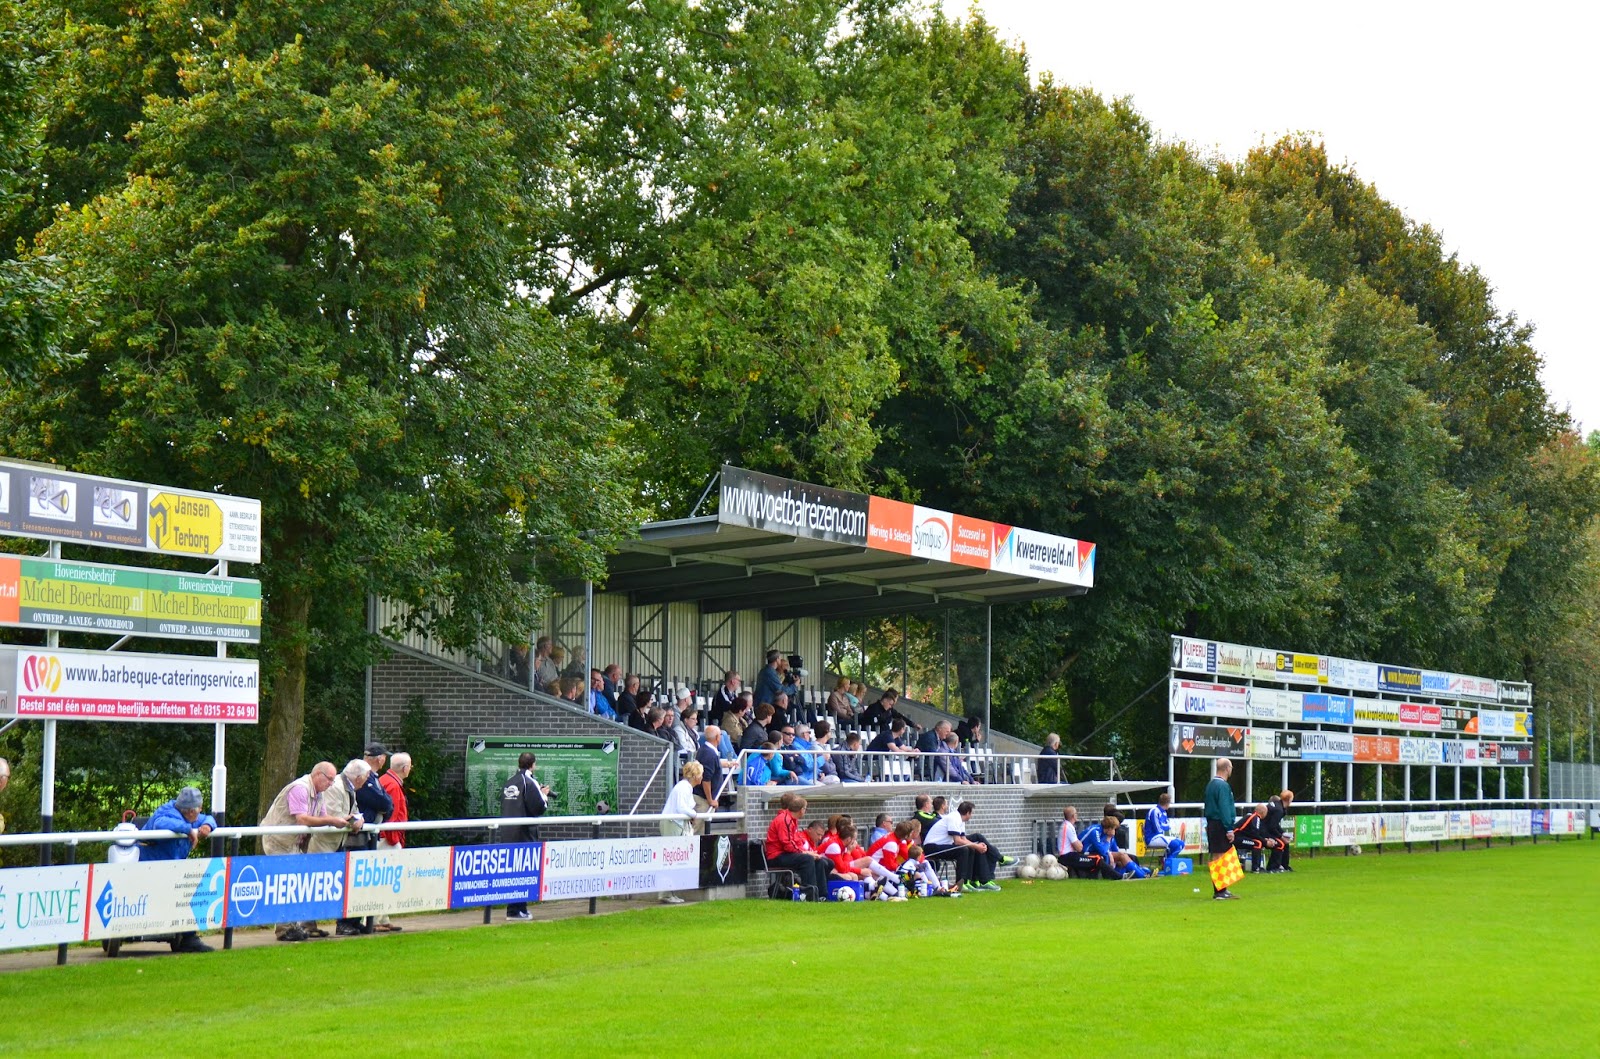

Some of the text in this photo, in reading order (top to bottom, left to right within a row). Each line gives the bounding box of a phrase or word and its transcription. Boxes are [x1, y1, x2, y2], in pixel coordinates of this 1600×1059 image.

[174, 495, 210, 518] Jansen
[723, 486, 867, 537] www.voetbalreizen.com
[173, 525, 210, 554] Terborg
[869, 523, 912, 543] Werving & Selectie
[914, 525, 942, 556] Symbus
[958, 525, 986, 542] Succesvol in
[953, 541, 989, 559] Loopbaanadvies
[1016, 534, 1076, 568] kwerreveld.nl
[54, 563, 117, 585] Hoveniersbedrijf
[23, 579, 145, 614] Michel Boerkamp.nl
[178, 577, 234, 597] Hoveniersbedrijf
[151, 592, 258, 624] Michel Boerkamp.nl
[33, 612, 134, 630] ONTWERP AANLEG ONDERHOUD
[159, 623, 250, 638] ONTWERP AANLEG ONDERHOUD
[65, 664, 257, 691] www.barbeque-cateringservice.nl
[20, 698, 46, 711] Bestel
[47, 699, 64, 712] snel
[66, 698, 80, 713] één
[81, 703, 96, 714] van
[97, 703, 116, 714] onze
[117, 701, 149, 718] heerlijke
[151, 702, 186, 716] buffetten
[189, 703, 203, 716] Tel:
[203, 704, 221, 717] 0315
[226, 706, 235, 717] 32
[236, 706, 246, 717] 64
[246, 706, 255, 717] 90
[454, 846, 542, 877] KOERSELMAN
[550, 843, 652, 870] Paul Klomberg Assurantiën
[662, 845, 690, 866] RegioBank
[353, 857, 403, 893] Ebbing
[415, 866, 445, 879] Heerenberg
[613, 875, 656, 890] HYPOTHEKEN
[234, 885, 261, 898] NISSAN
[264, 869, 343, 906] HERWERS
[454, 876, 538, 891] BOUWMACHINES BOUWBENODIGDHEDEN
[549, 878, 605, 896] VERZEKERINGEN
[16, 880, 81, 929] UNIVÉ
[352, 902, 384, 913] vakschilders
[396, 896, 424, 909] truckfinish
[463, 889, 529, 904] www.koerselmanbouwmachines.nl
